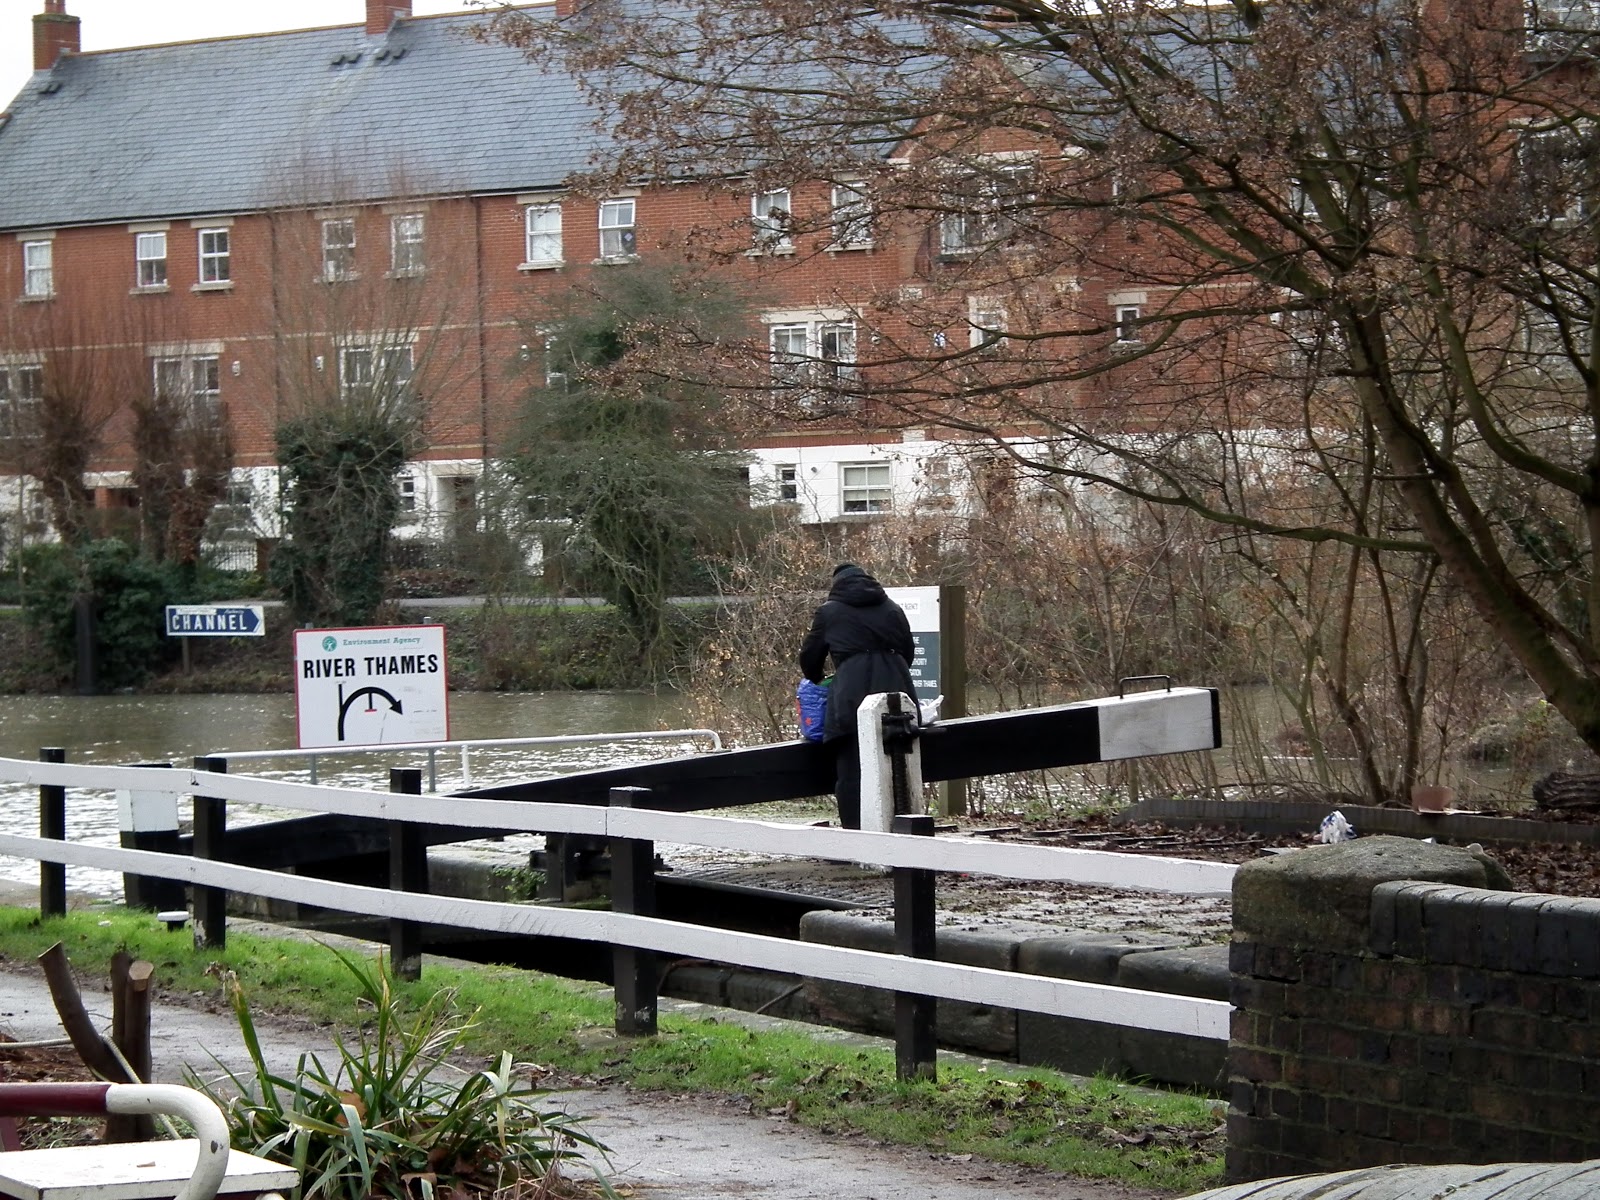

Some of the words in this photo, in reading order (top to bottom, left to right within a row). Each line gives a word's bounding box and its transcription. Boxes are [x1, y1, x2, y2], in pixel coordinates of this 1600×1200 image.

[172, 615, 247, 630] CHANNEL
[342, 638, 391, 646] Environment
[392, 636, 421, 645] Agency
[304, 658, 355, 678] RIVER
[364, 654, 438, 675] THAMES
